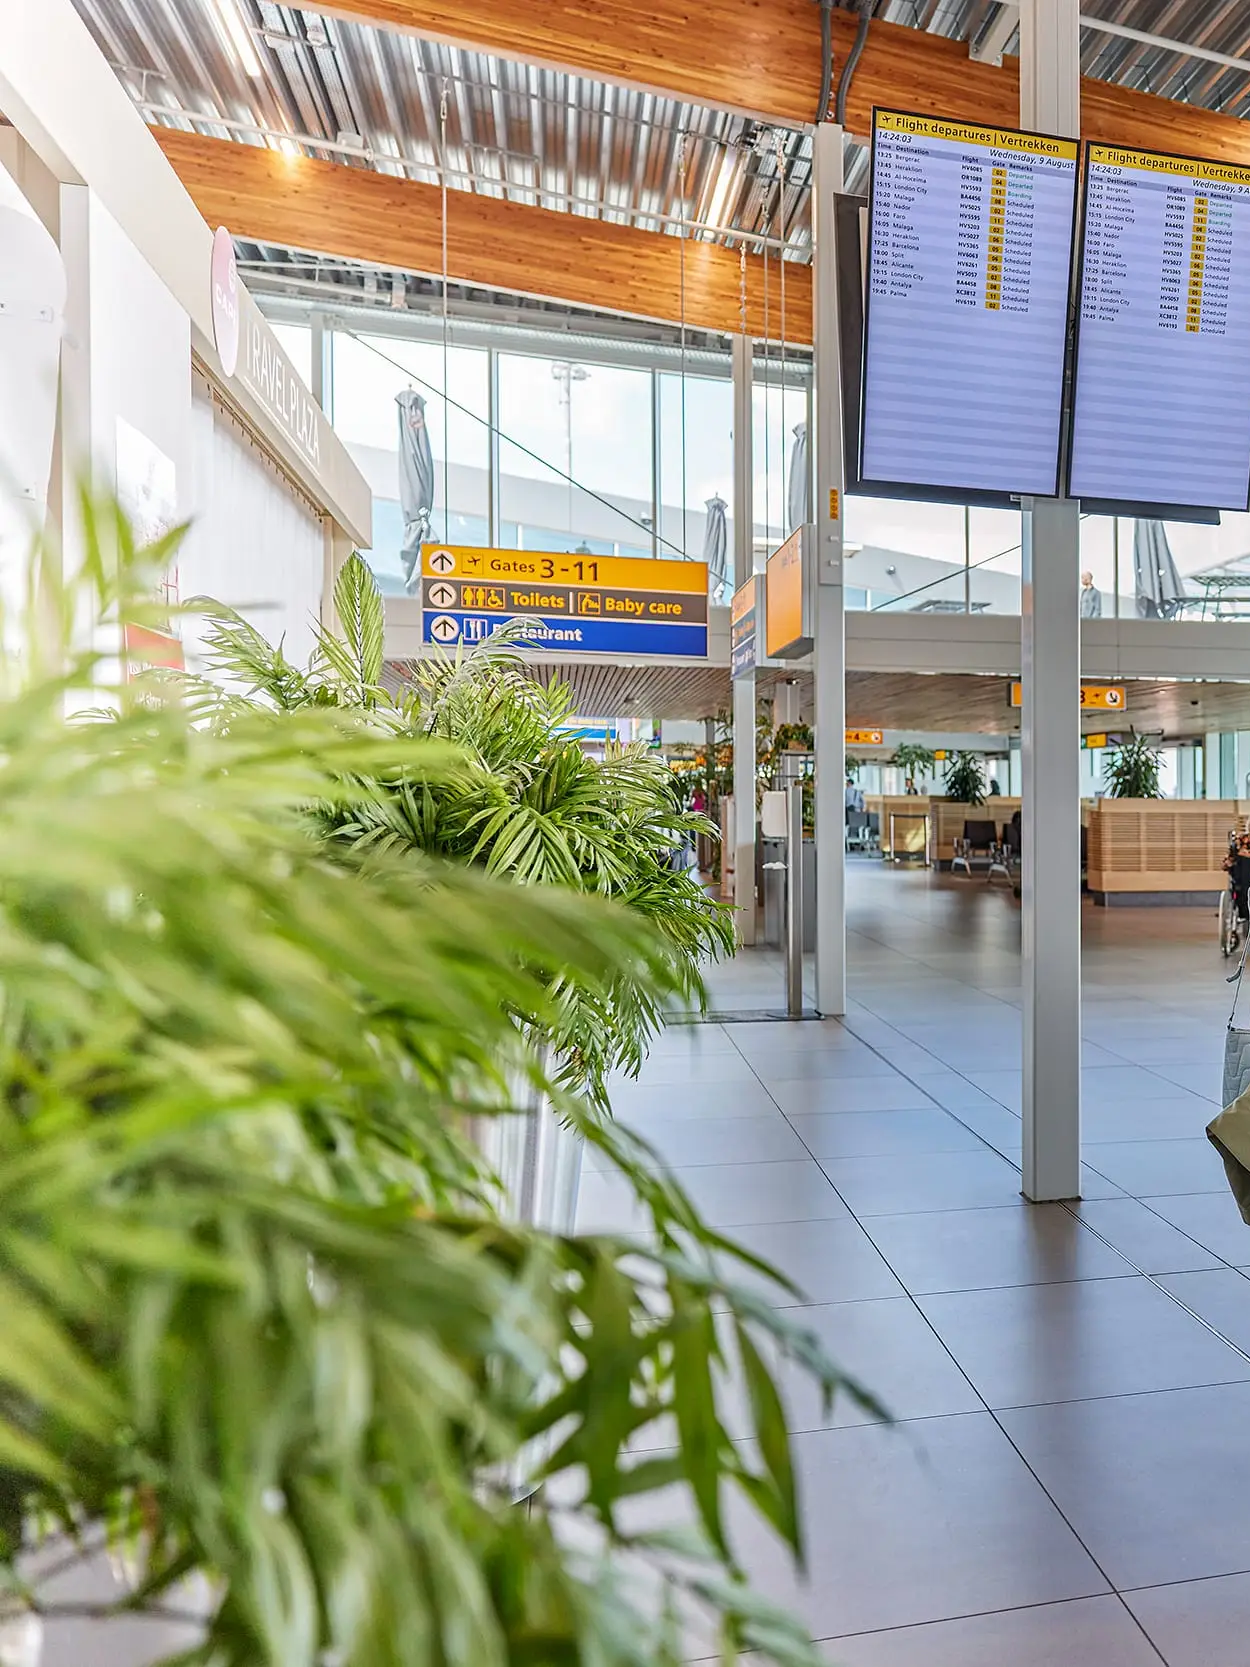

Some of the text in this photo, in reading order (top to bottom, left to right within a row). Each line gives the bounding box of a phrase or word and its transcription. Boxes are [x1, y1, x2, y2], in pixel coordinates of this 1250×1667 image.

[878, 130, 912, 144] 14:24:03
[895, 117, 1059, 153] Flight departures Vertrekken
[895, 145, 929, 155] Destination
[961, 155, 978, 164] Flight
[1008, 162, 1032, 172] Remarks
[989, 148, 1074, 170] Wednesday, 9 August
[1107, 151, 1138, 166] Flight
[1139, 156, 1194, 173] departures
[1091, 164, 1122, 176] 14:24:03
[1007, 171, 1034, 182] Departed
[1007, 180, 1033, 191] Departed
[1106, 177, 1137, 186] Destination
[1209, 192, 1232, 200] Remarks
[1191, 179, 1236, 194] Wednesday,
[1237, 185, 1243, 193] 9
[893, 183, 916, 192] London
[916, 186, 927, 195] City
[1006, 199, 1034, 210] Scheduled
[1005, 209, 1033, 219] Scheduled
[1005, 218, 1033, 228] Scheduled
[1004, 228, 1032, 238] Scheduled
[1207, 227, 1233, 237] Scheduled
[1004, 237, 1032, 247] Scheduled
[1206, 236, 1232, 246] Scheduled
[1004, 247, 1031, 257] Scheduled
[1205, 245, 1231, 255] Scheduled
[1003, 256, 1031, 266] Scheduled
[1205, 254, 1231, 264] Scheduled
[1003, 266, 1030, 275] Scheduled
[1204, 263, 1230, 272] Scheduled
[1002, 275, 1030, 285] Scheduled
[1203, 272, 1229, 281] Scheduled
[890, 270, 912, 279] London
[912, 273, 923, 281] City
[1002, 284, 1029, 294] Scheduled
[1203, 281, 1229, 290] Scheduled
[1001, 294, 1029, 303] Scheduled
[1202, 290, 1228, 299] Scheduled
[1001, 303, 1028, 313] Scheduled
[1201, 299, 1227, 308] Scheduled
[1201, 308, 1227, 317] Scheduled
[1200, 317, 1226, 326] Scheduled
[1199, 326, 1225, 335] Scheduled
[289, 378, 321, 467] PLAZA
[490, 558, 536, 574] Gates
[510, 591, 566, 609] Toilets
[604, 596, 683, 616] Baby care
